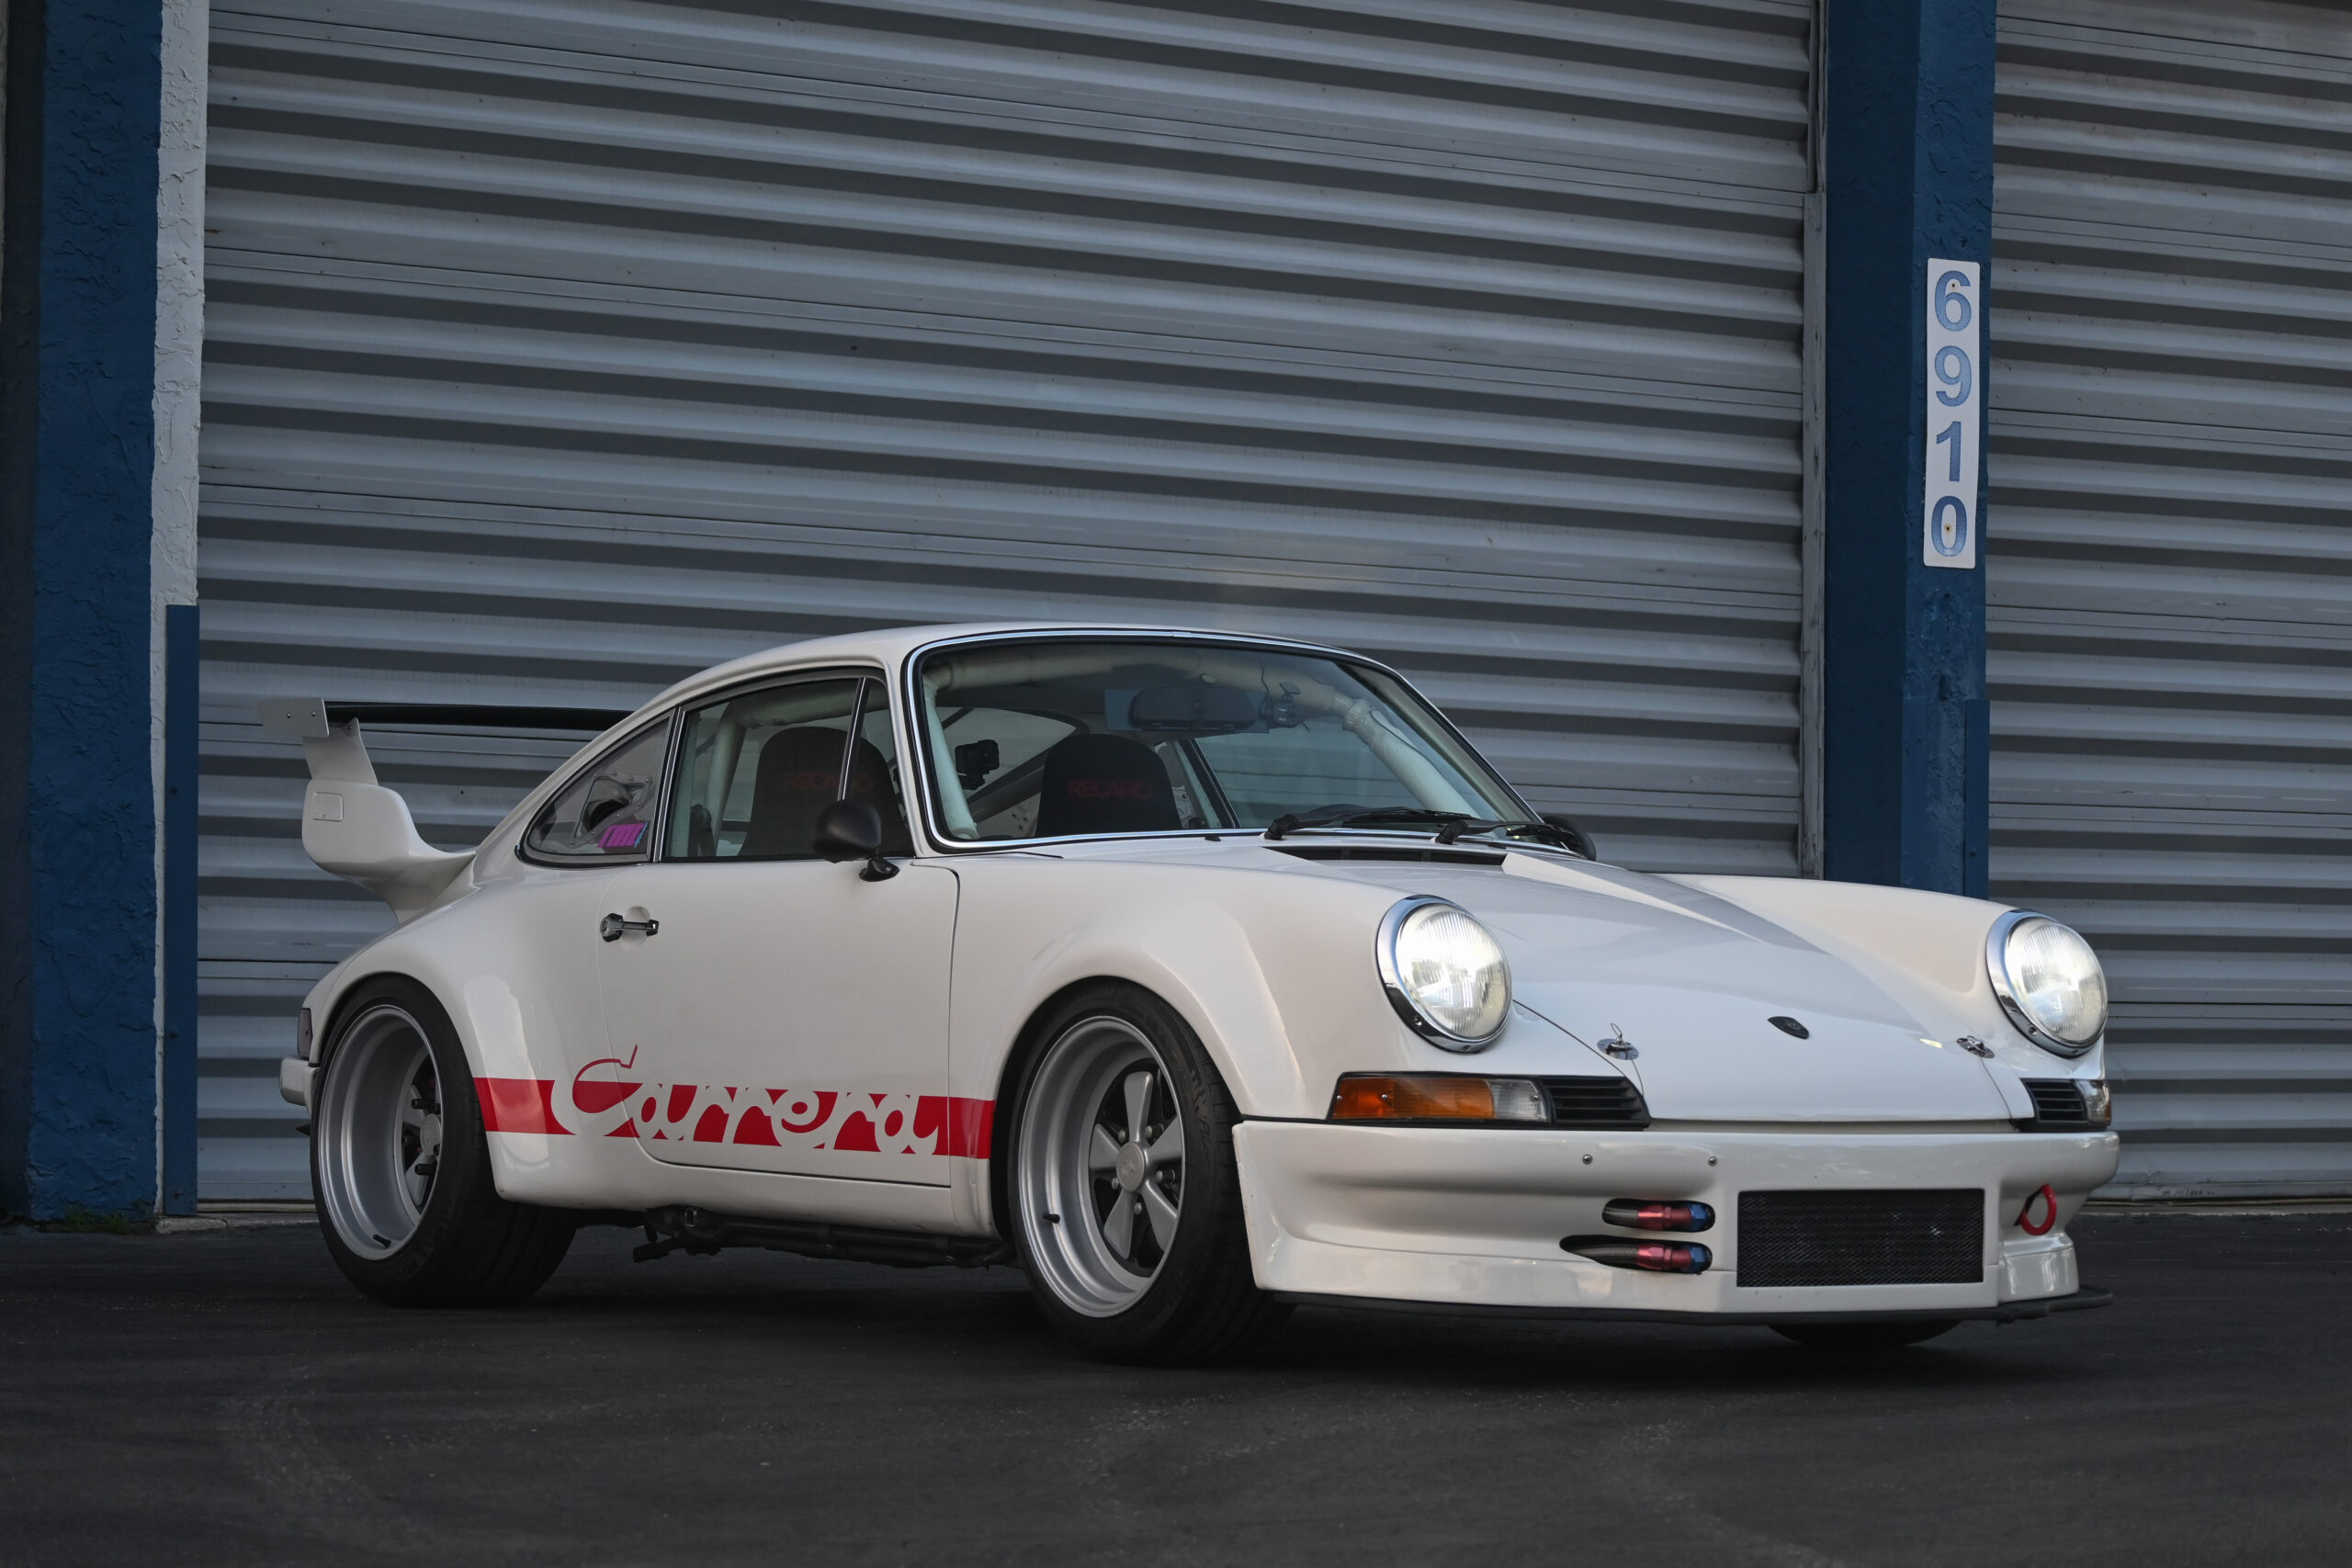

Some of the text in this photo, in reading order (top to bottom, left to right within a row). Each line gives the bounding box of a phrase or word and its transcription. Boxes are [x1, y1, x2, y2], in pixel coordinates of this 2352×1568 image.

[1931, 270, 1972, 558] 6910
[783, 772, 875, 792] RECAO
[1068, 779, 1154, 799] RECARO
[551, 1044, 939, 1156] Carrera
